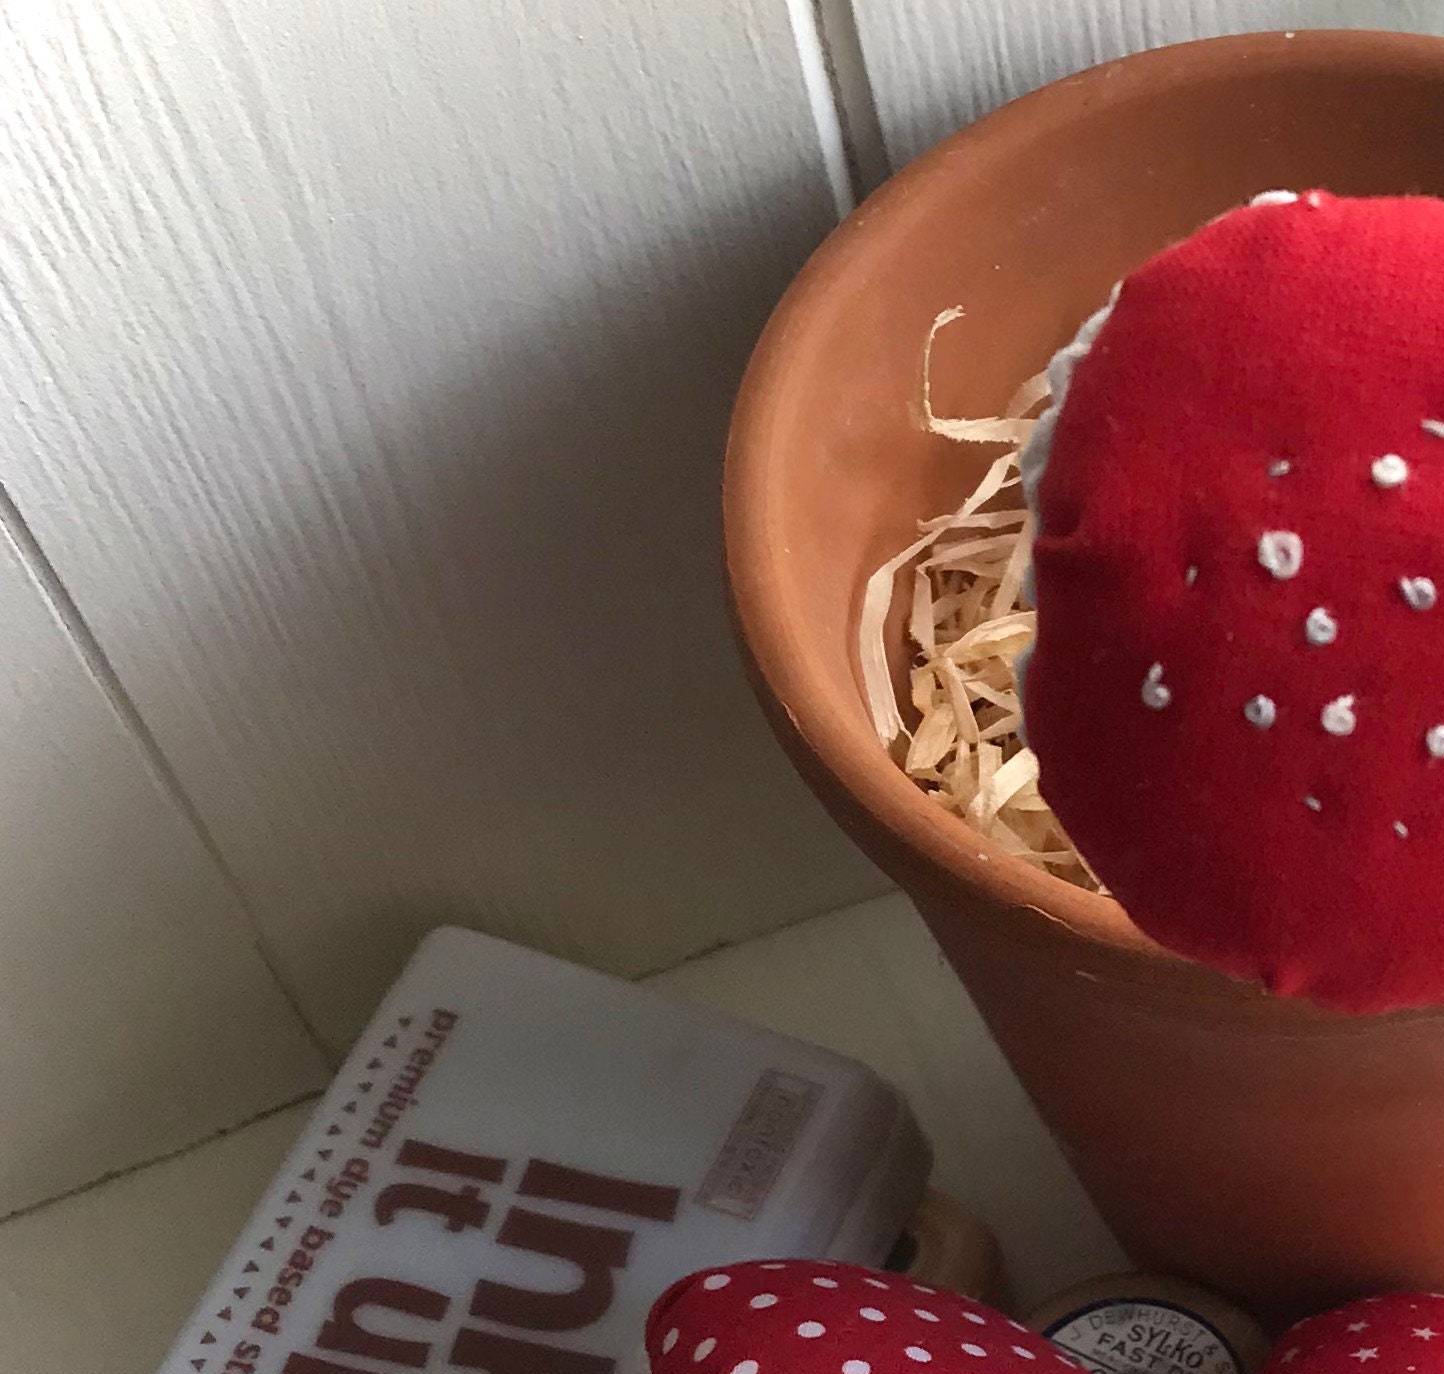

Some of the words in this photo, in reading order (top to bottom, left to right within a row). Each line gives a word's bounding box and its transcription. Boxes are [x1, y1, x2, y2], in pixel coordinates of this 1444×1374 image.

[360, 1007, 459, 1150] premium
[319, 1157, 370, 1219] dye
[374, 1138, 508, 1233] It
[251, 1224, 335, 1335] based
[1088, 1308, 1207, 1342] DEWHURST
[1097, 1332, 1163, 1369] FAST
[1126, 1323, 1205, 1370] SYLKO
